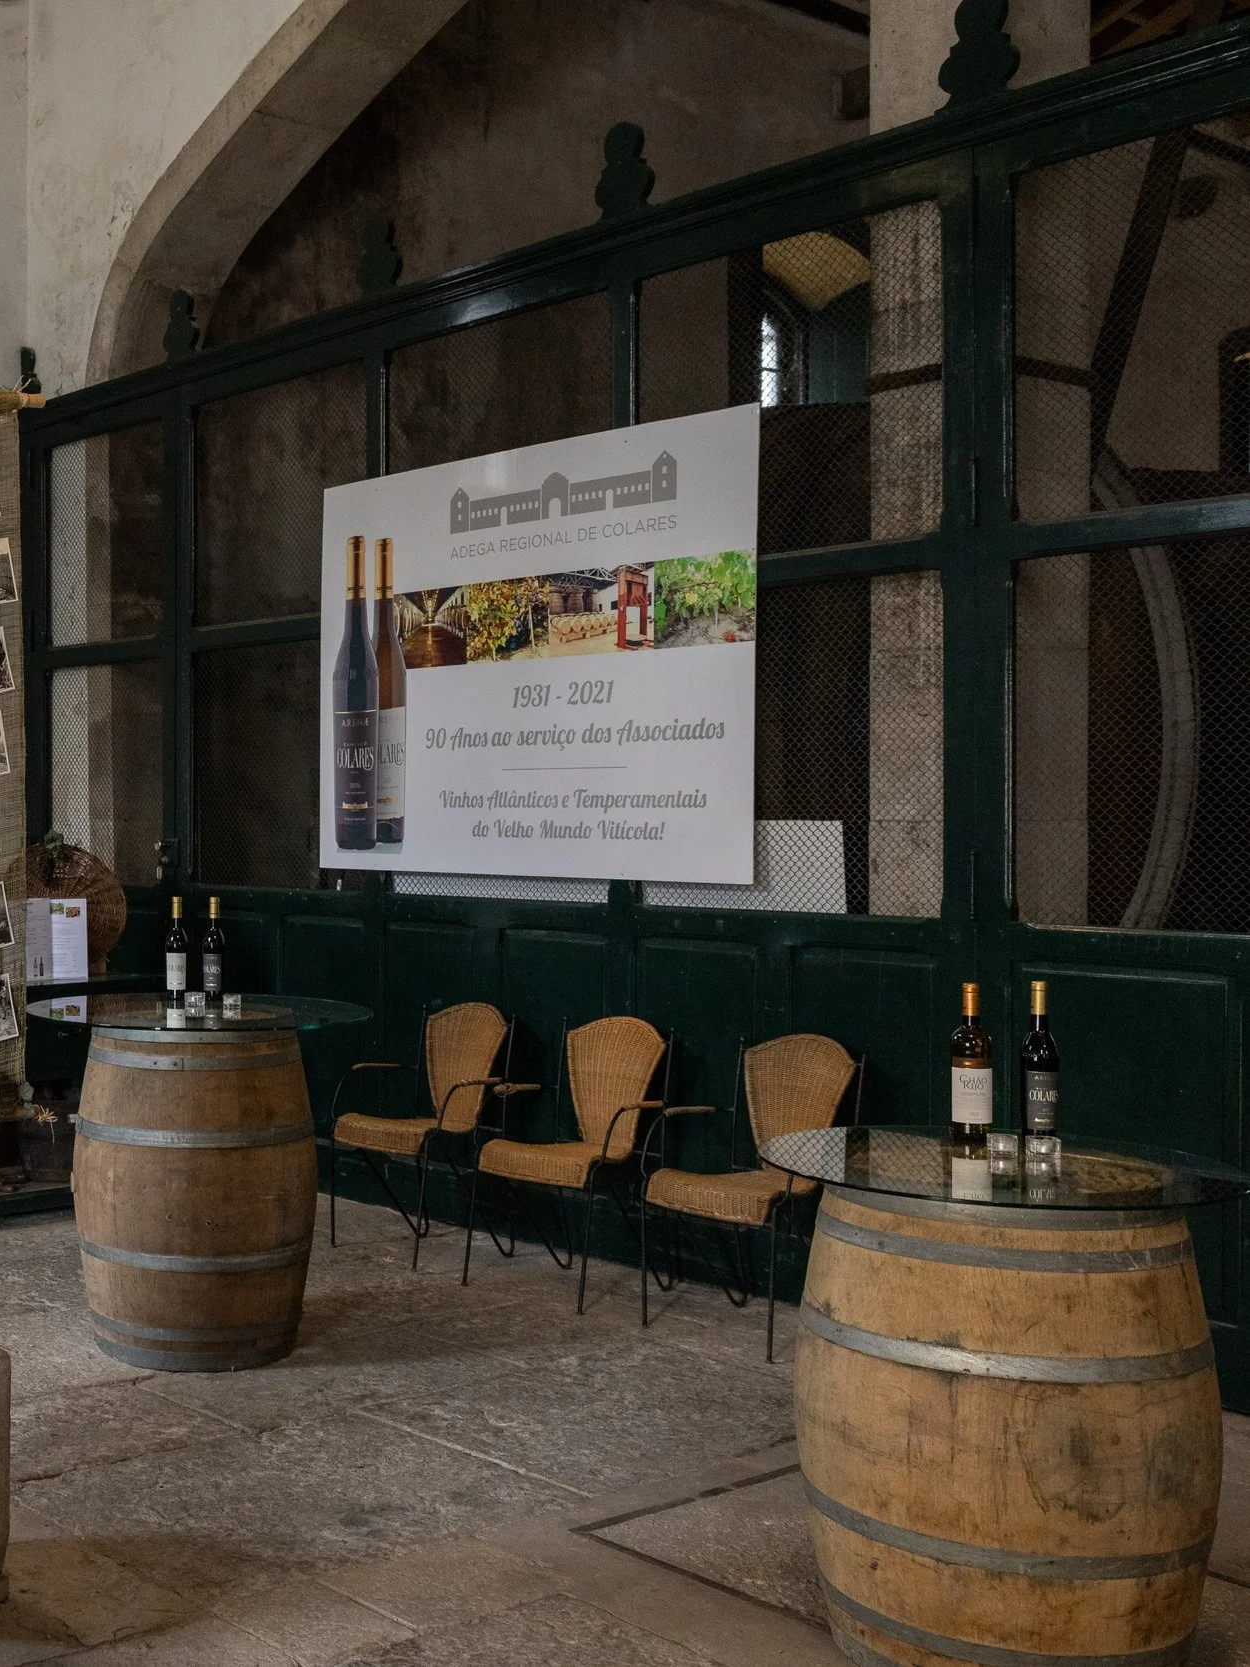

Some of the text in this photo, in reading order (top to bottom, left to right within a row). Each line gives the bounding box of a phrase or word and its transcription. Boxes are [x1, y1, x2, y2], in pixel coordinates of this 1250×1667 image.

[450, 515, 677, 560] ADEGA REGIONAL DE COLARES
[512, 684, 551, 708] 1931
[567, 680, 614, 705] 2021
[425, 717, 726, 751] 90 Anos ao serviço dos Associados
[336, 746, 375, 771] COLARES
[438, 788, 708, 813] Vinhos Atlânticos e Temperamentais
[472, 819, 666, 841] do Velho Mundo Vitícola!
[959, 1074, 988, 1084] CHÃO
[963, 1080, 985, 1090] RIJO
